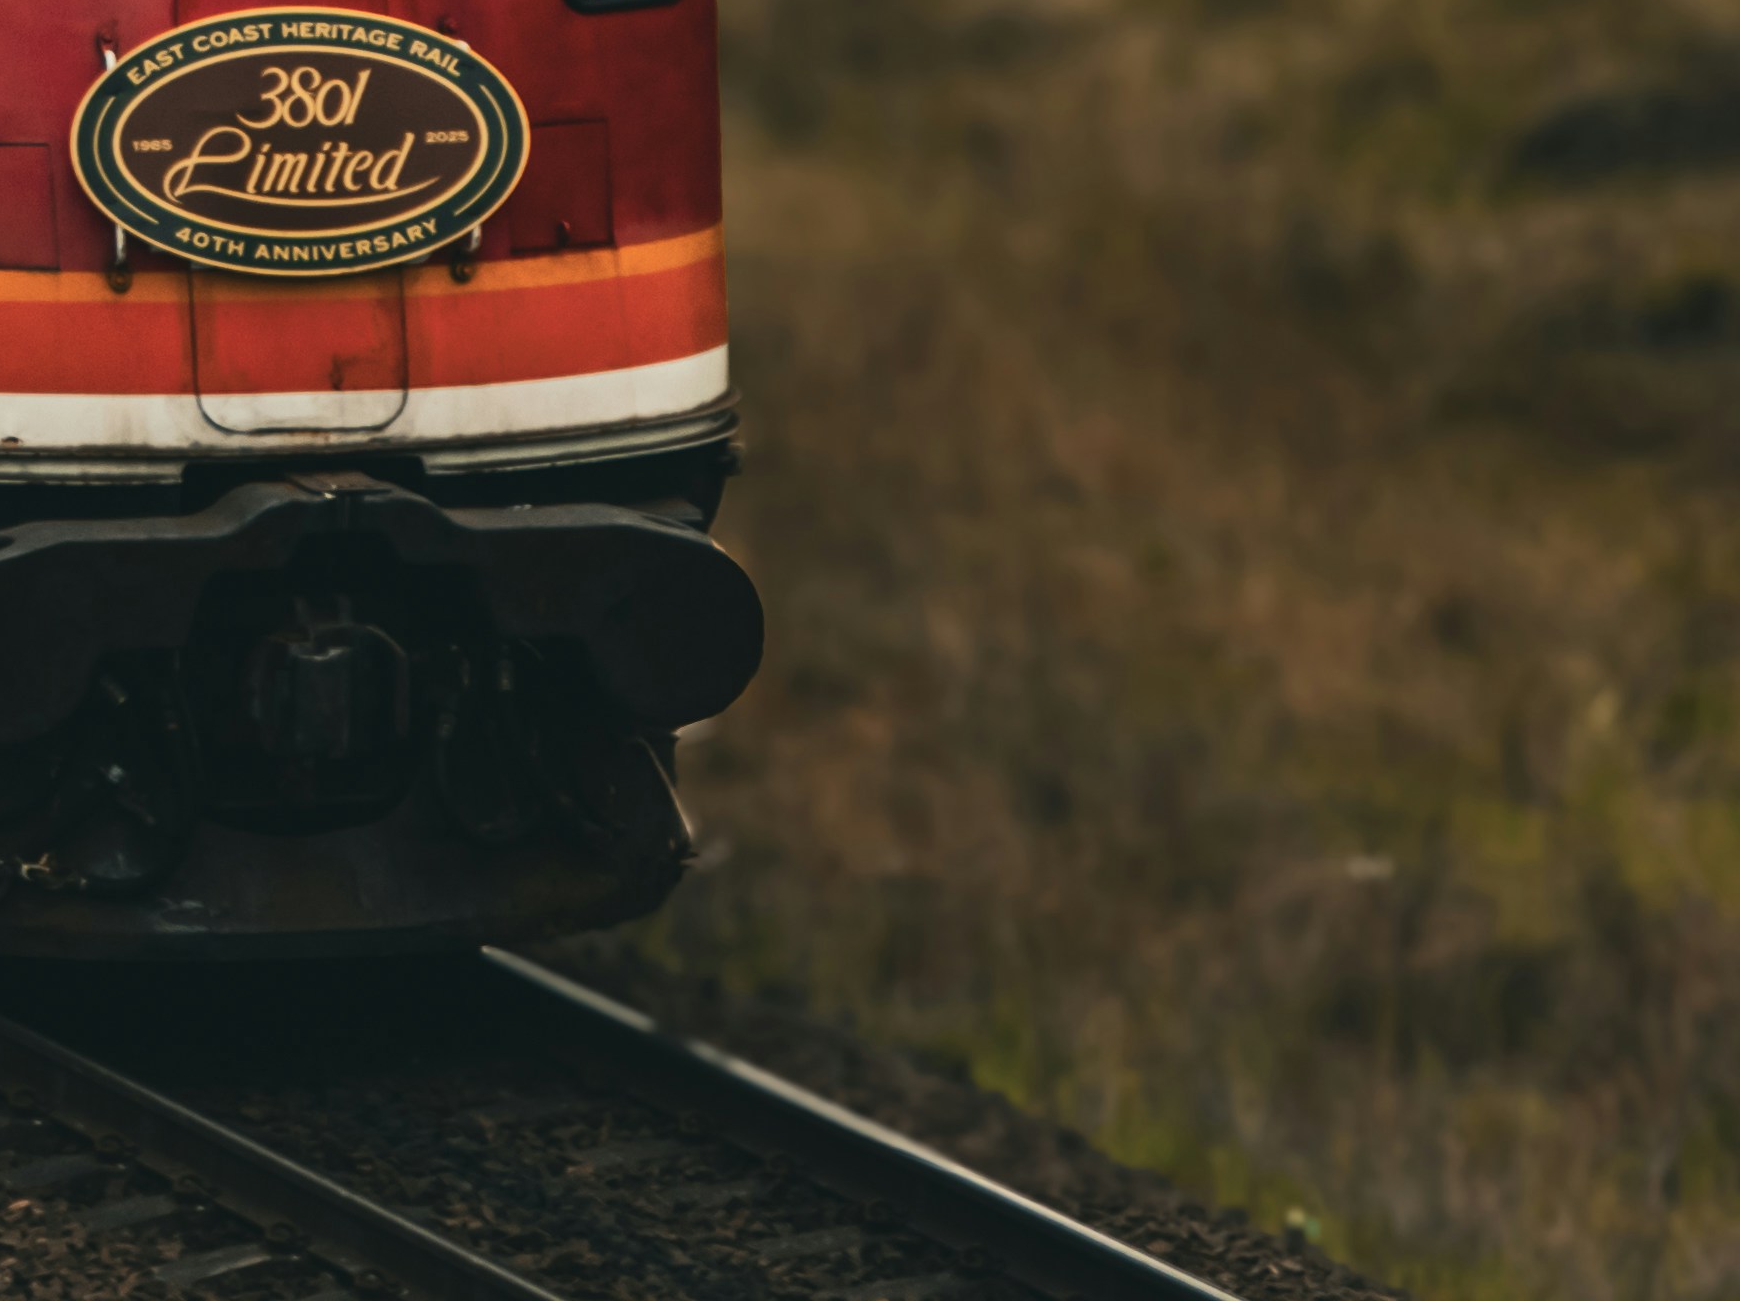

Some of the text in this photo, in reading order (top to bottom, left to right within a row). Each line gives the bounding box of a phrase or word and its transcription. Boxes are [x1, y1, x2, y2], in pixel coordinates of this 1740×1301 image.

[126, 21, 462, 85] EAST COAST HERITAGE RAIL
[236, 66, 372, 129] 3801
[163, 126, 441, 207] Limited
[425, 130, 470, 144] 2025
[175, 217, 439, 262] 40TH ANNIVERSARY
